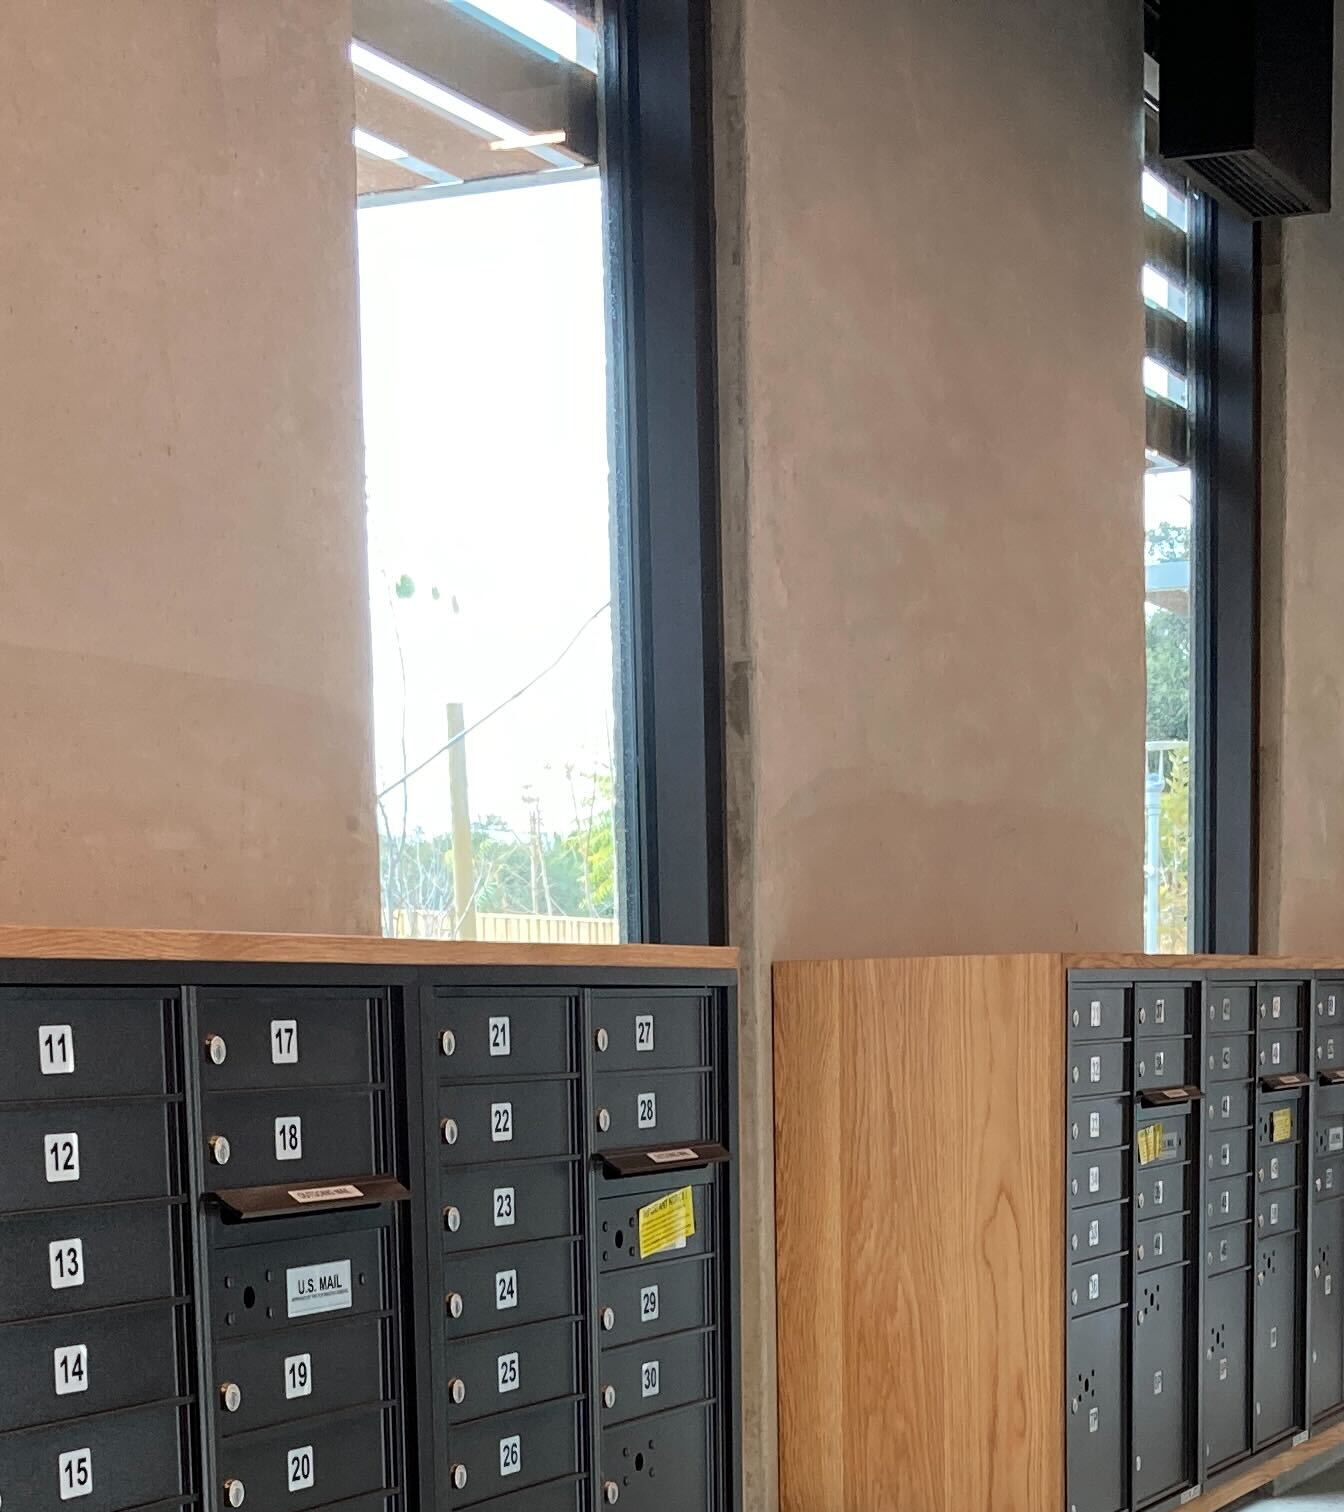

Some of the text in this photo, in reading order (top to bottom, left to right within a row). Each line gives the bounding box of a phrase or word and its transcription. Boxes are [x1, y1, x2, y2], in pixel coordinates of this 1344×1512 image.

[275, 1027, 294, 1055] 17
[492, 1023, 506, 1047] 21
[638, 1021, 651, 1044] 27
[44, 1033, 67, 1064] 11
[494, 1109, 510, 1133] 22
[640, 1099, 654, 1121] 28
[279, 1124, 298, 1151] 18
[50, 1141, 75, 1172] 12
[496, 1194, 512, 1218] 23
[55, 1247, 79, 1278] 13
[298, 1278, 317, 1295] U.S.
[319, 1274, 343, 1291] MAIL
[498, 1276, 515, 1302] 24
[643, 1291, 657, 1315] 29
[60, 1353, 84, 1384] 14
[289, 1361, 308, 1389] 19
[500, 1359, 517, 1385] 25
[644, 1367, 657, 1390] 30
[291, 1453, 310, 1482] 20
[502, 1442, 518, 1468] 26
[64, 1457, 88, 1489] 15
